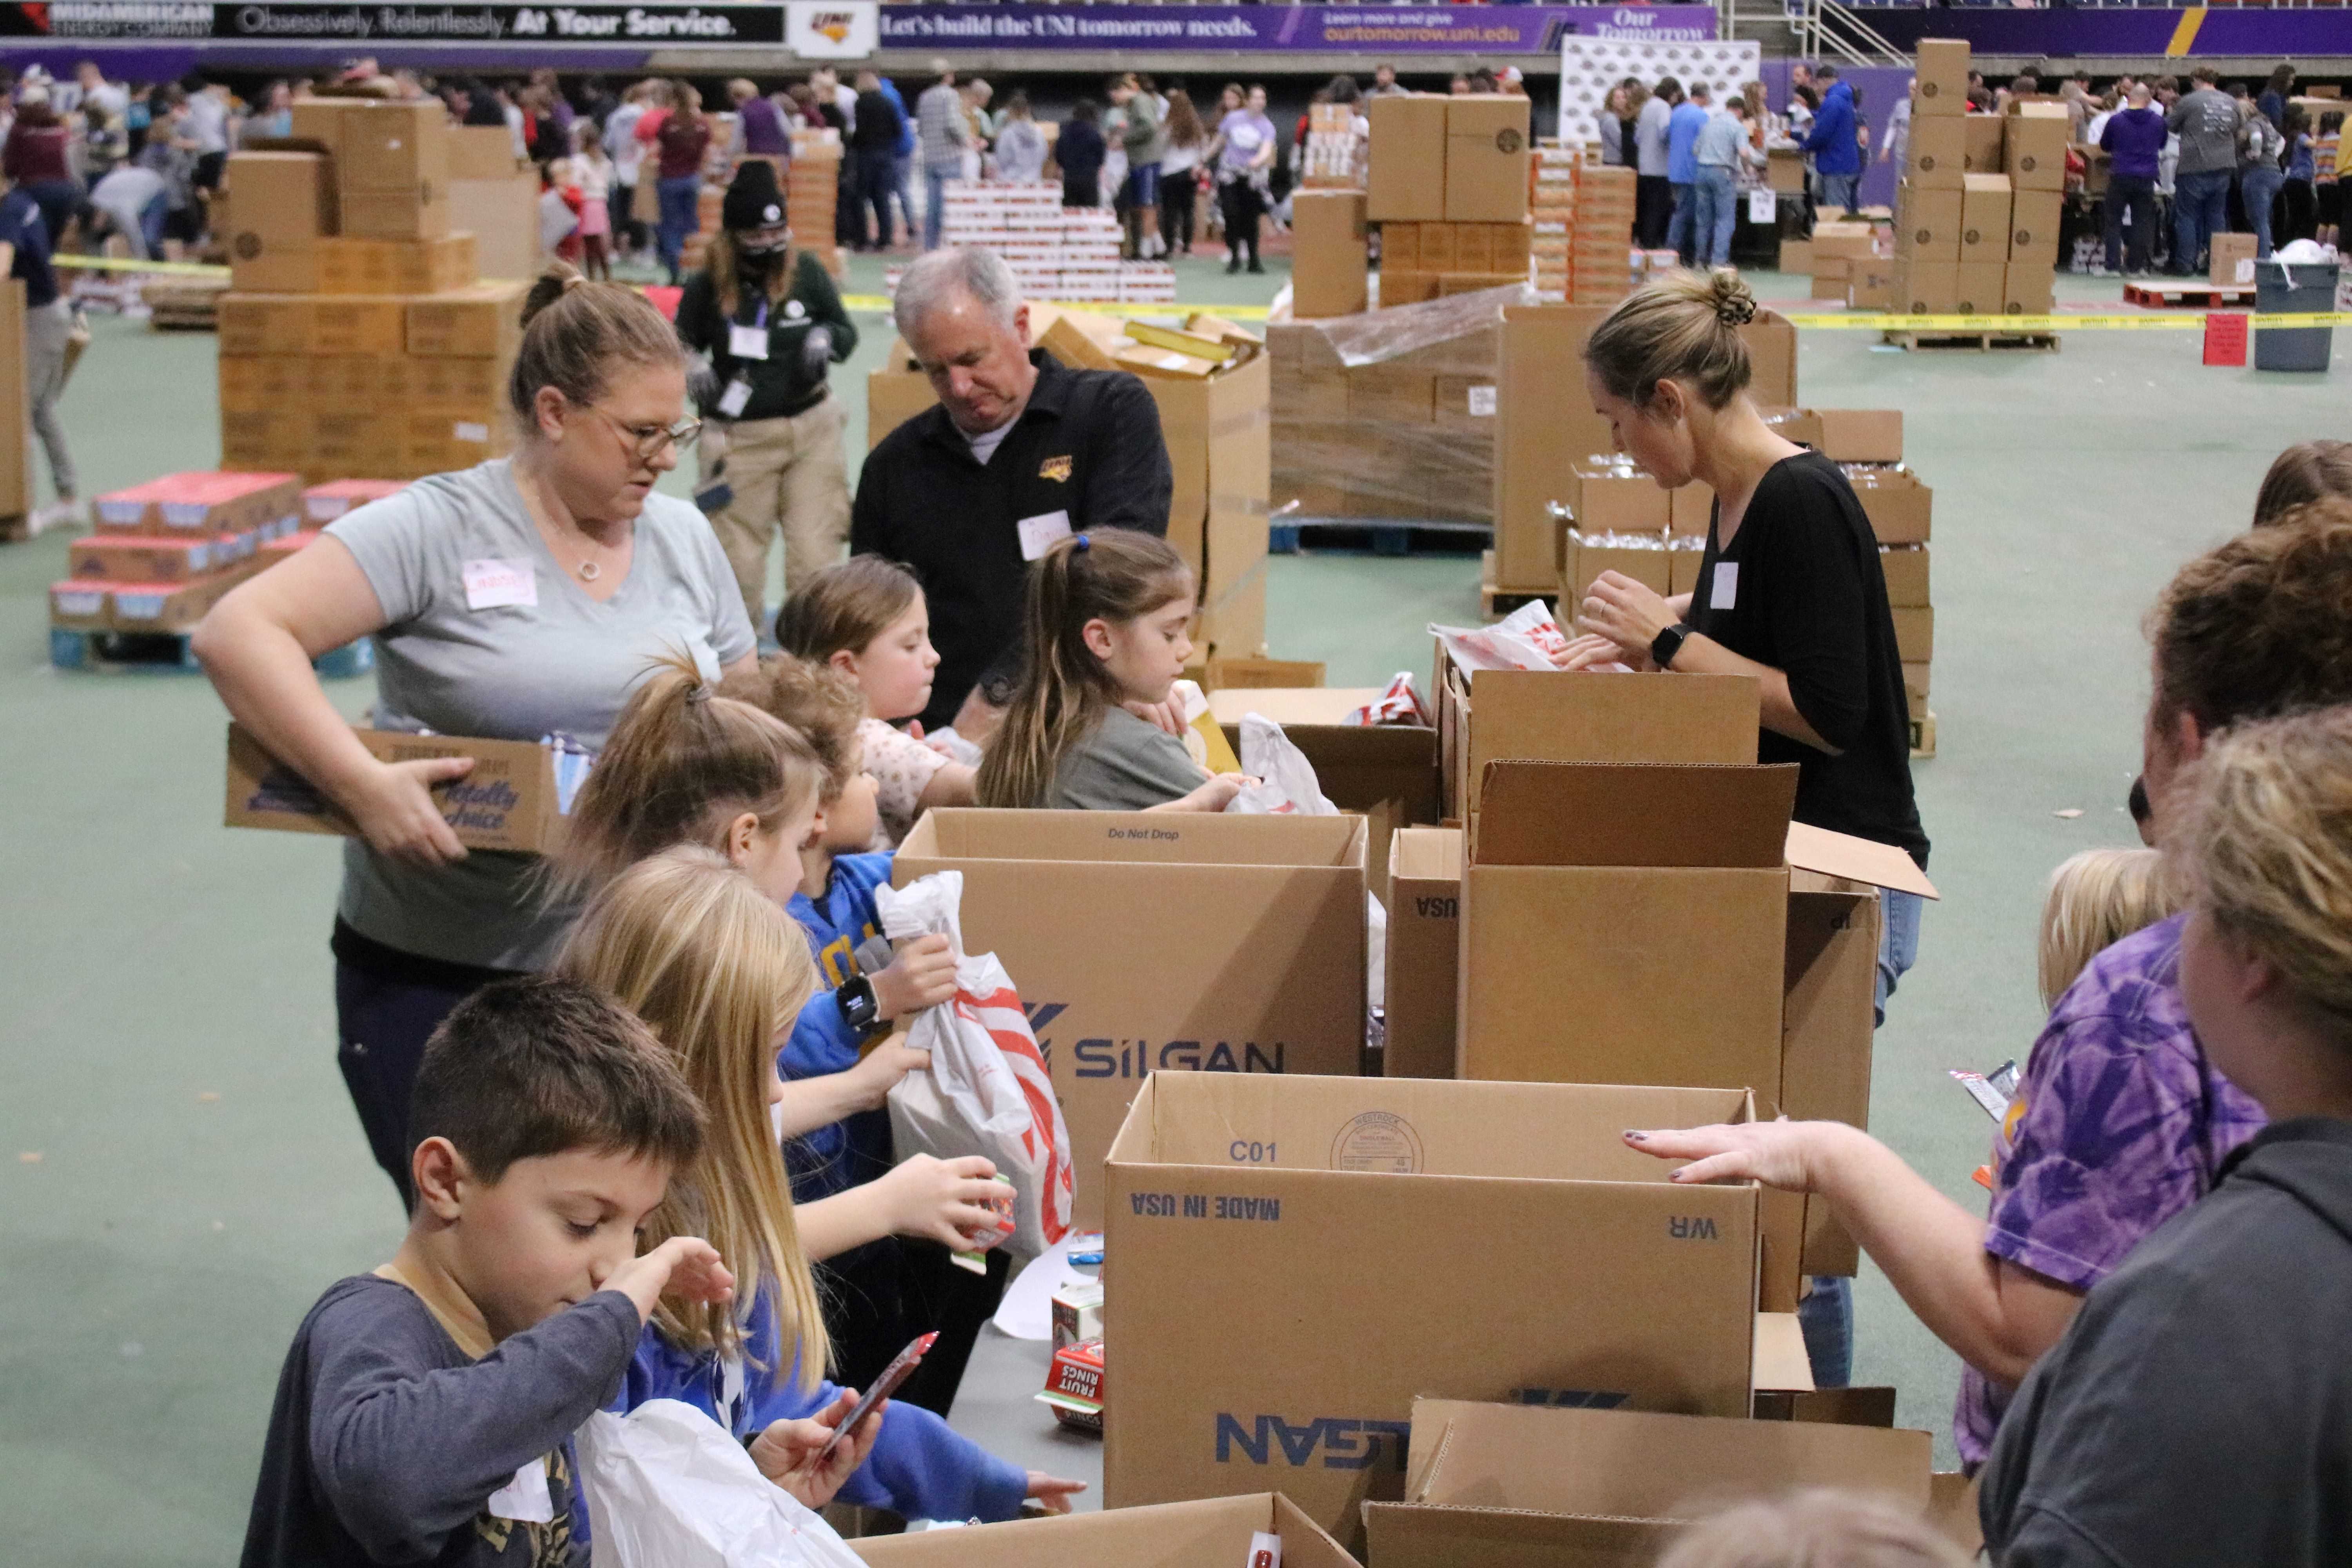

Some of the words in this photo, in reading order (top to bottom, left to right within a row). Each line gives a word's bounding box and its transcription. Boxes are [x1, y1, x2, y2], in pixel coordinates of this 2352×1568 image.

[512, 8, 548, 34] At
[552, 8, 622, 35] Your
[625, 7, 737, 35] Service.
[880, 14, 934, 35] Let's
[935, 14, 992, 36] build
[994, 14, 1032, 36] the
[1033, 15, 1075, 36] UNI
[1076, 17, 1183, 36] tomorrow
[1187, 15, 1257, 36] needs.
[1323, 12, 1361, 25] Learn
[1363, 14, 1396, 25] more
[1398, 12, 1424, 25] and
[1425, 13, 1453, 27] give
[1613, 8, 1657, 27] Our
[1324, 26, 1520, 42] ourtomorrow.uni.edu
[1596, 24, 1708, 40] Tomorrow
[1108, 828, 1124, 838] Do
[1127, 828, 1149, 838] Not
[1151, 829, 1180, 841] Drop
[1416, 897, 1458, 918] USA
[1354, 1114, 1400, 1127] WESTROCK
[1230, 1140, 1276, 1162] C01
[1131, 1192, 1176, 1217] USA
[1183, 1194, 1207, 1218] IN
[1215, 1196, 1280, 1221] MADE
[1670, 1216, 1718, 1240] WR
[1062, 1365, 1099, 1386] RINGS
[1059, 1377, 1096, 1398] FRUIT
